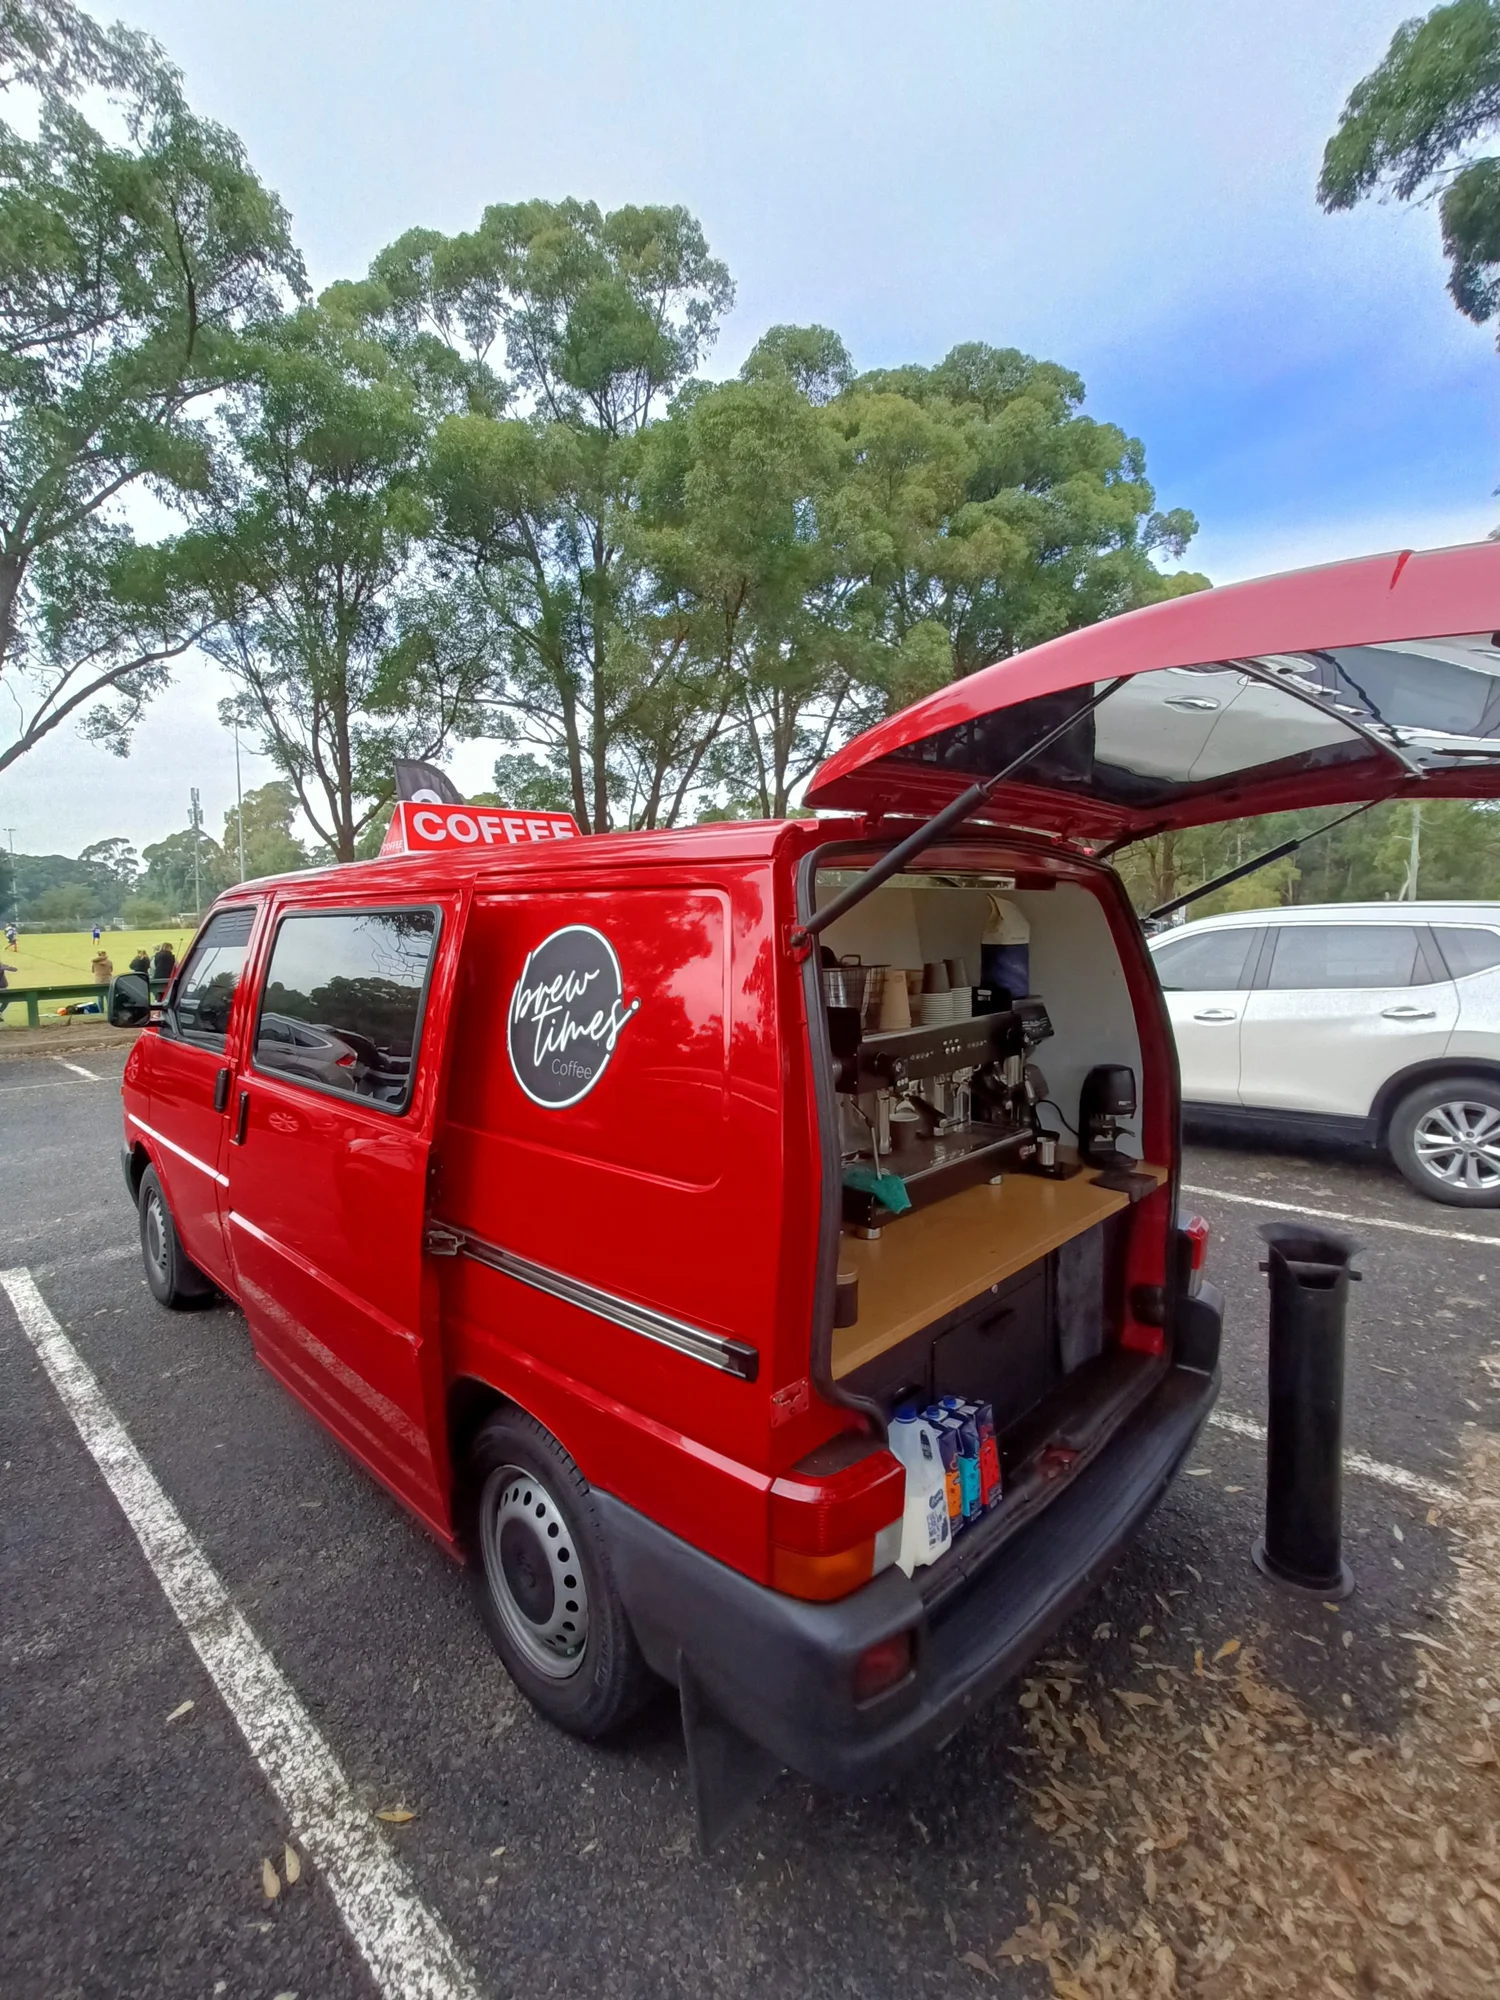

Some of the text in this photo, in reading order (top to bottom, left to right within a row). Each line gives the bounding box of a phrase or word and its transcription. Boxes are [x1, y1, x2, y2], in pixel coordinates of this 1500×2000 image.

[412, 810, 574, 844] COFFEE
[514, 951, 600, 1024] brew
[551, 1058, 593, 1080] Coffee
